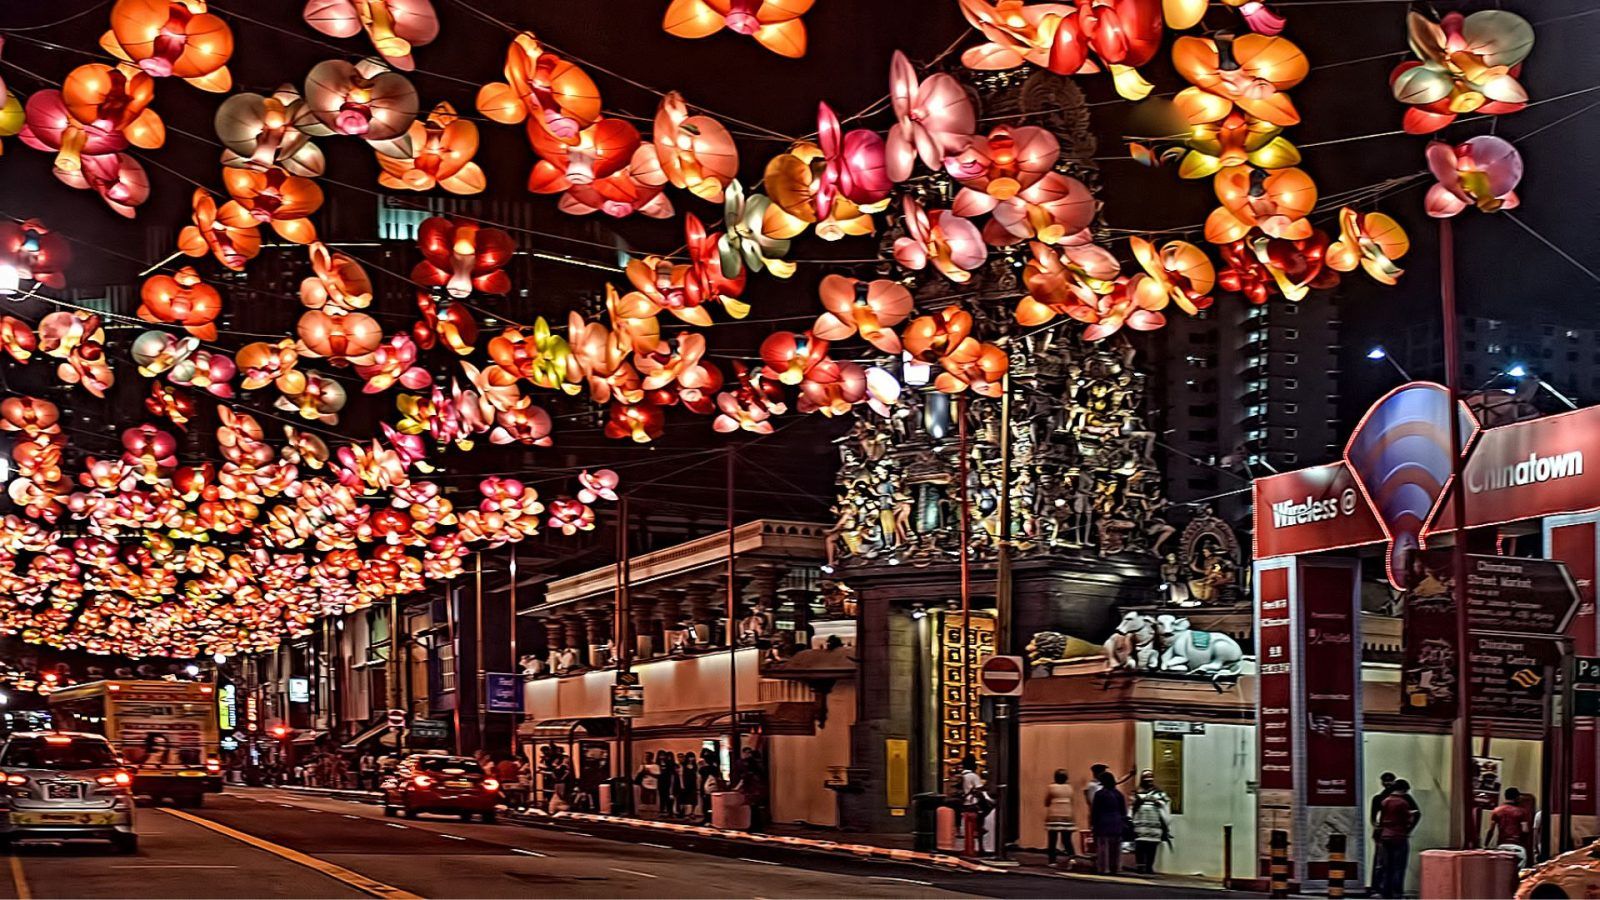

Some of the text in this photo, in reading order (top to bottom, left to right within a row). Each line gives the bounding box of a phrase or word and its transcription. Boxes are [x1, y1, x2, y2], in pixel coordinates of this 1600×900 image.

[1468, 450, 1583, 493] Chinatown
[1272, 488, 1357, 528] Wireless @
